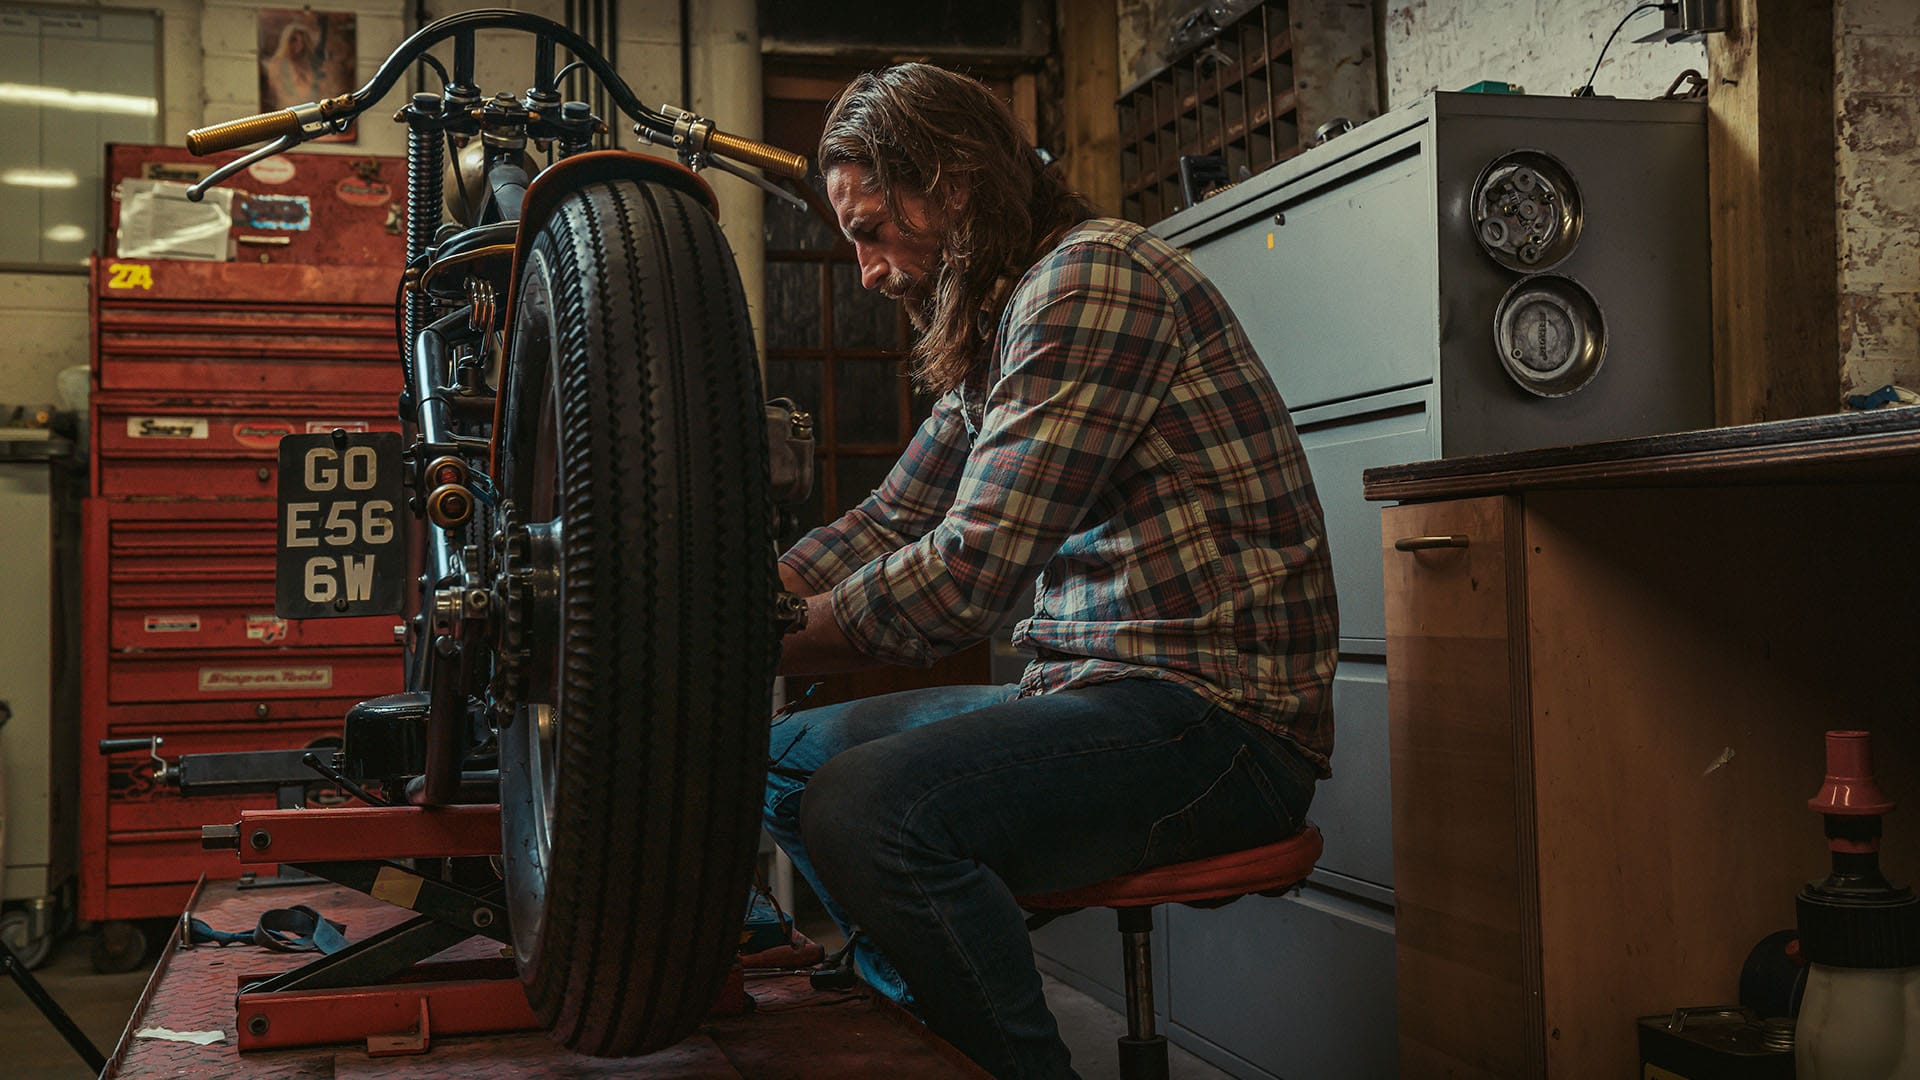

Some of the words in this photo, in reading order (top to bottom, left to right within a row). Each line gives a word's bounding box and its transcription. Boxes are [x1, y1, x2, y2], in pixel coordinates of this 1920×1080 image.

[304, 447, 377, 491] GO
[286, 500, 394, 548] E56
[304, 554, 375, 602] 6W
